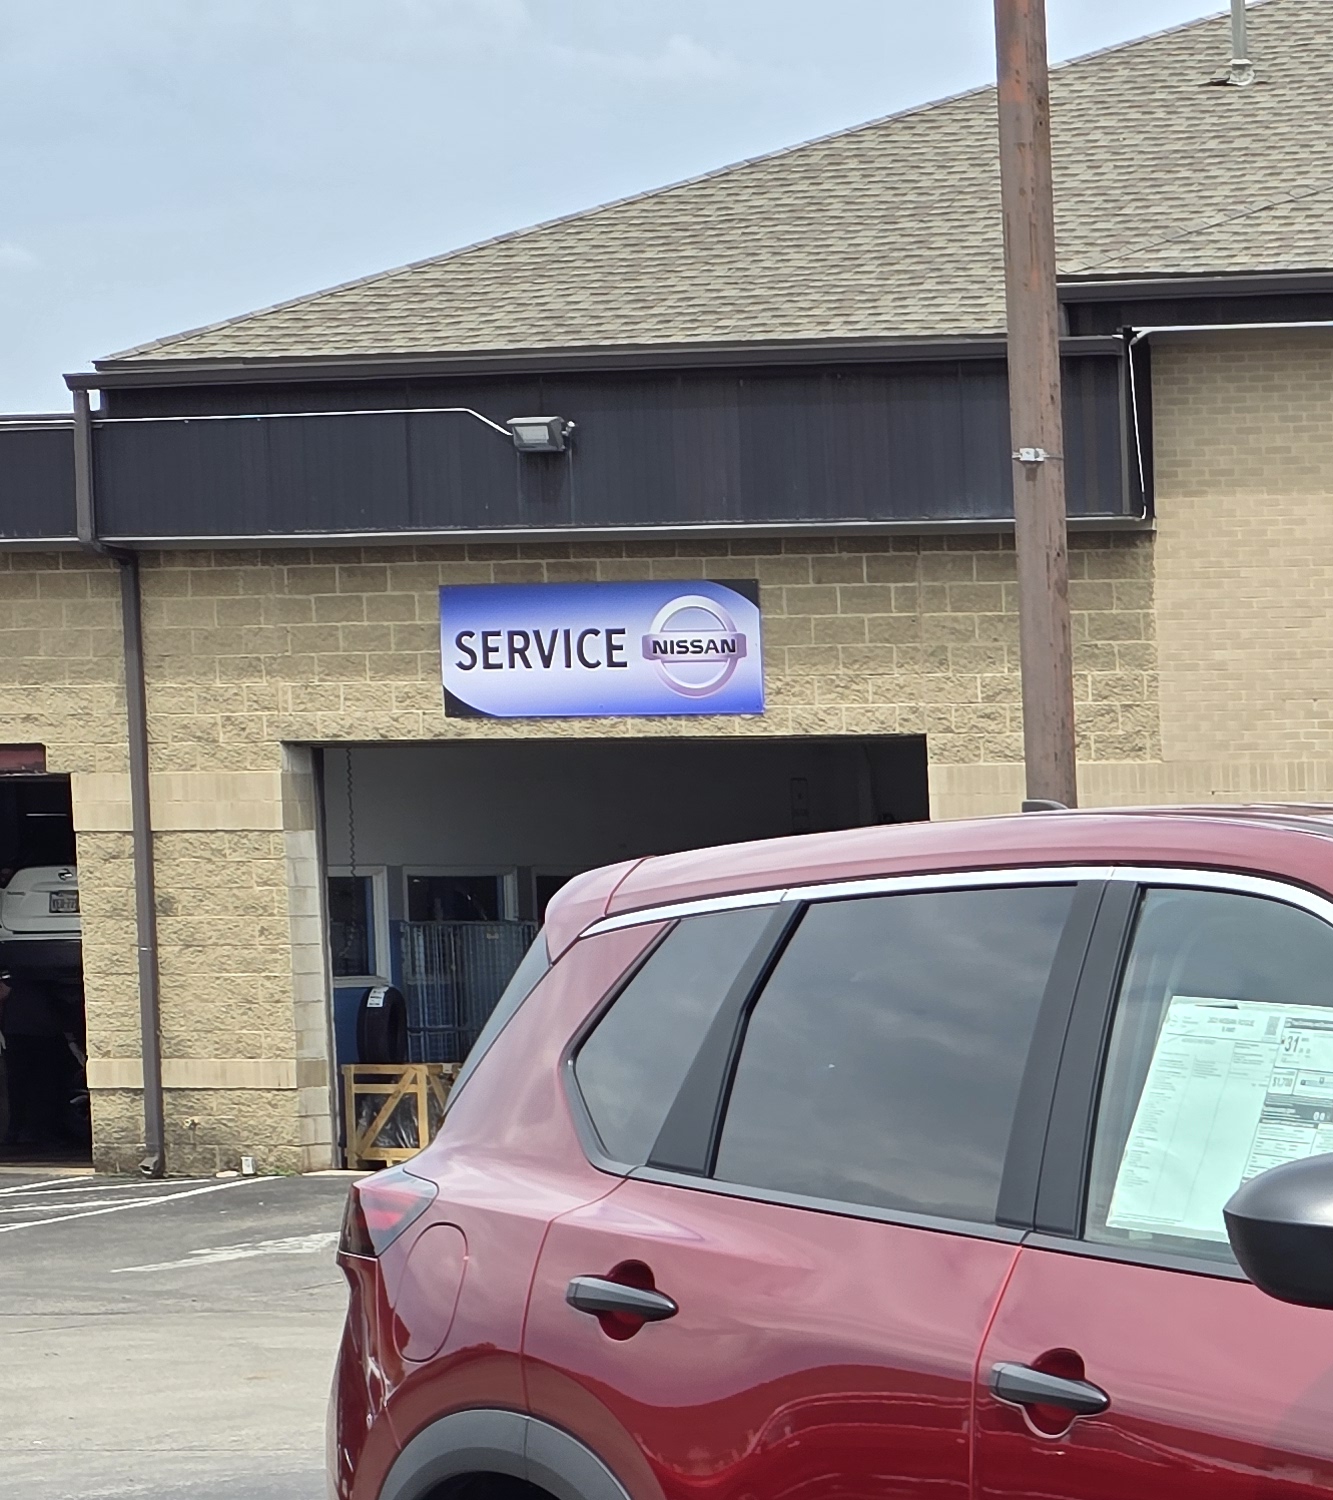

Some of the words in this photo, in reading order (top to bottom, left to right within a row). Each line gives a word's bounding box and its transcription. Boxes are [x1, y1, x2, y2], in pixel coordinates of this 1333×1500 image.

[454, 627, 629, 671] SERVICE
[652, 637, 737, 656] NISSAN
[1284, 1035, 1300, 1053] 31
